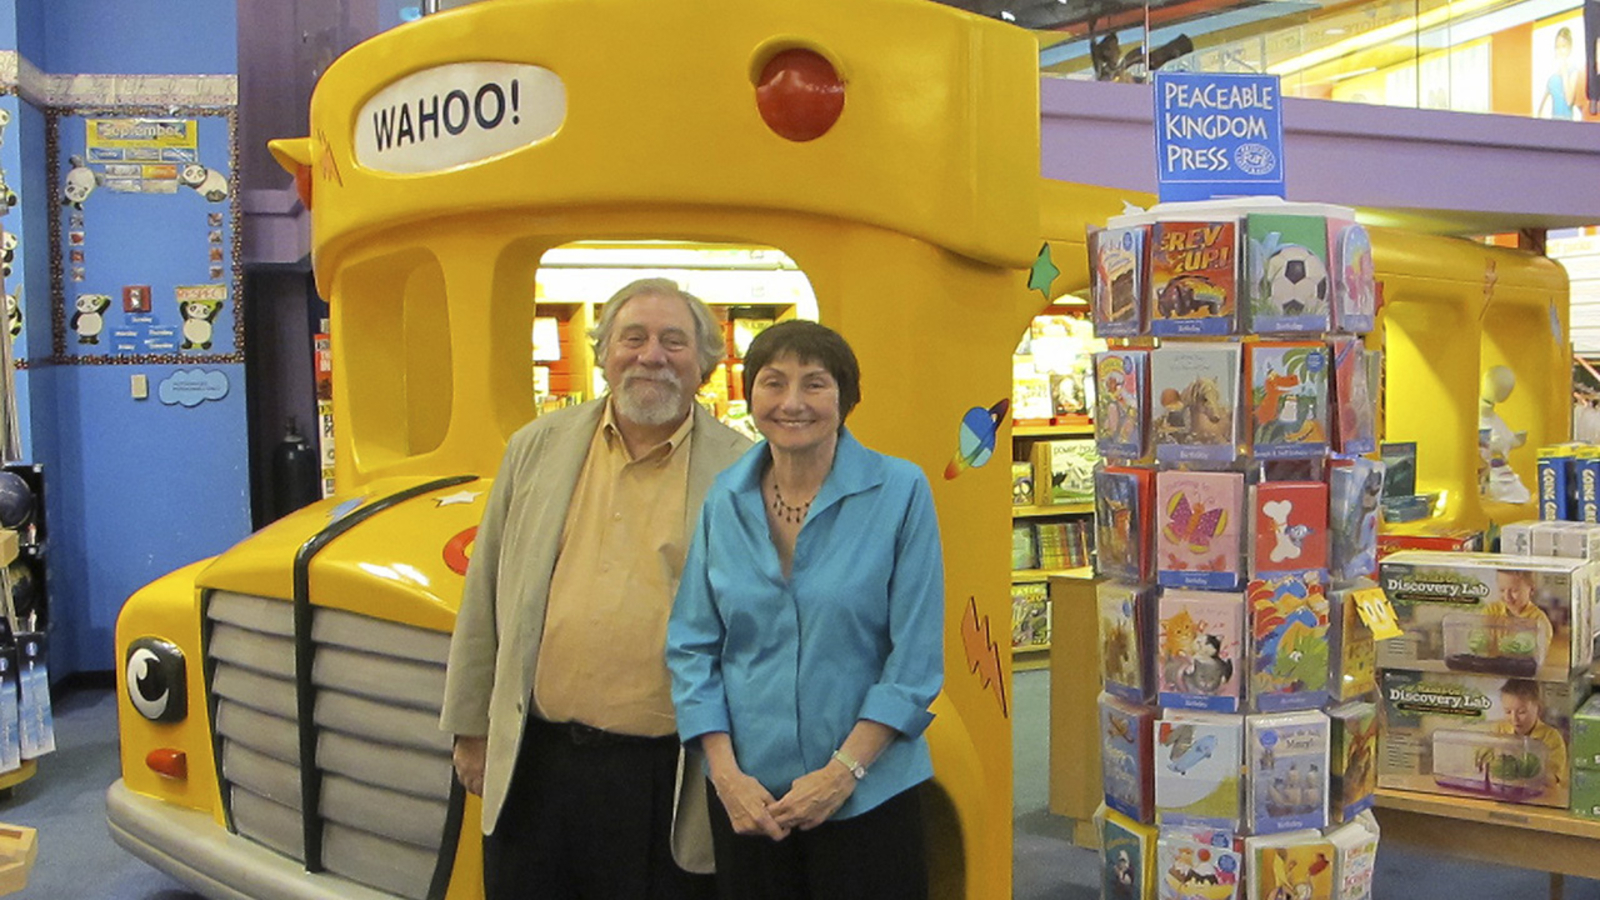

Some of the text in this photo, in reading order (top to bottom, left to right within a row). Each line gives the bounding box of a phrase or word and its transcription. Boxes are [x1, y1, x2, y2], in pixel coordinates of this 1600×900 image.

[1165, 82, 1273, 110] PEACEABLE
[374, 79, 520, 152] WAHOO!
[1165, 112, 1268, 140] KINGDOM
[1388, 579, 1490, 597] Discovery Lab
[1389, 689, 1492, 709] Discovery Lab
